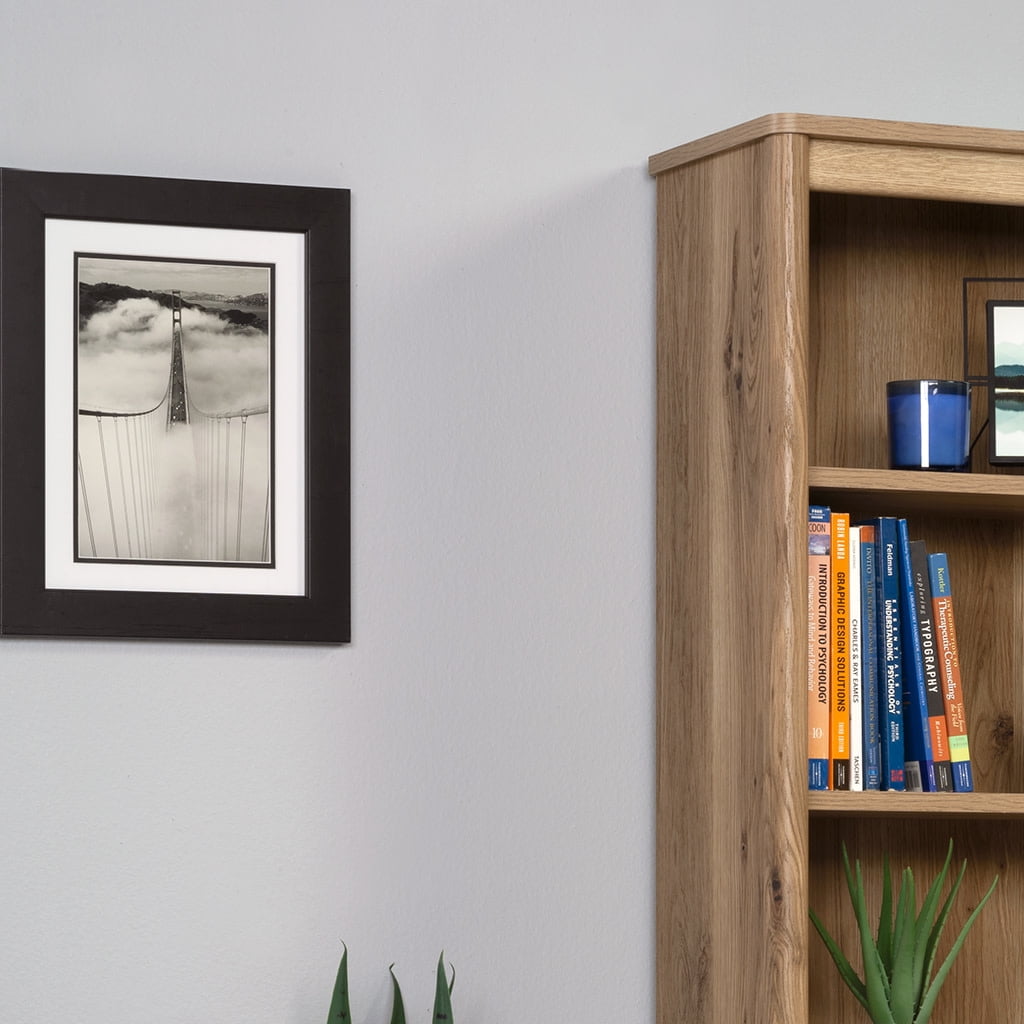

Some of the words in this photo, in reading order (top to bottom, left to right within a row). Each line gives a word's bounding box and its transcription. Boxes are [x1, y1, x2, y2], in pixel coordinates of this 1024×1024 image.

[836, 518, 846, 538] ROBIN
[836, 540, 846, 560] LANDA
[886, 543, 894, 576] Feldman
[937, 567, 946, 593] Kottler
[818, 563, 827, 631] INTRODUCTION
[836, 571, 846, 615] GRAPHIC
[916, 572, 927, 615] exploring
[818, 633, 827, 645] TO
[836, 617, 846, 653] DESIGN
[885, 599, 894, 661] UNDERSTANDING
[892, 599, 900, 688] ESSENTIALS
[938, 598, 951, 651] Therapeutic
[946, 600, 957, 655] INTRODUCTION
[953, 658, 959, 667] TO
[818, 647, 827, 704] PSYCHOLOGY
[920, 618, 938, 693] TYPOGRAPHY
[944, 651, 957, 700] Counseling
[836, 656, 846, 712] SOLUTIONS
[887, 665, 896, 714] PSYCHOLOGY
[895, 700, 901, 715] OF
